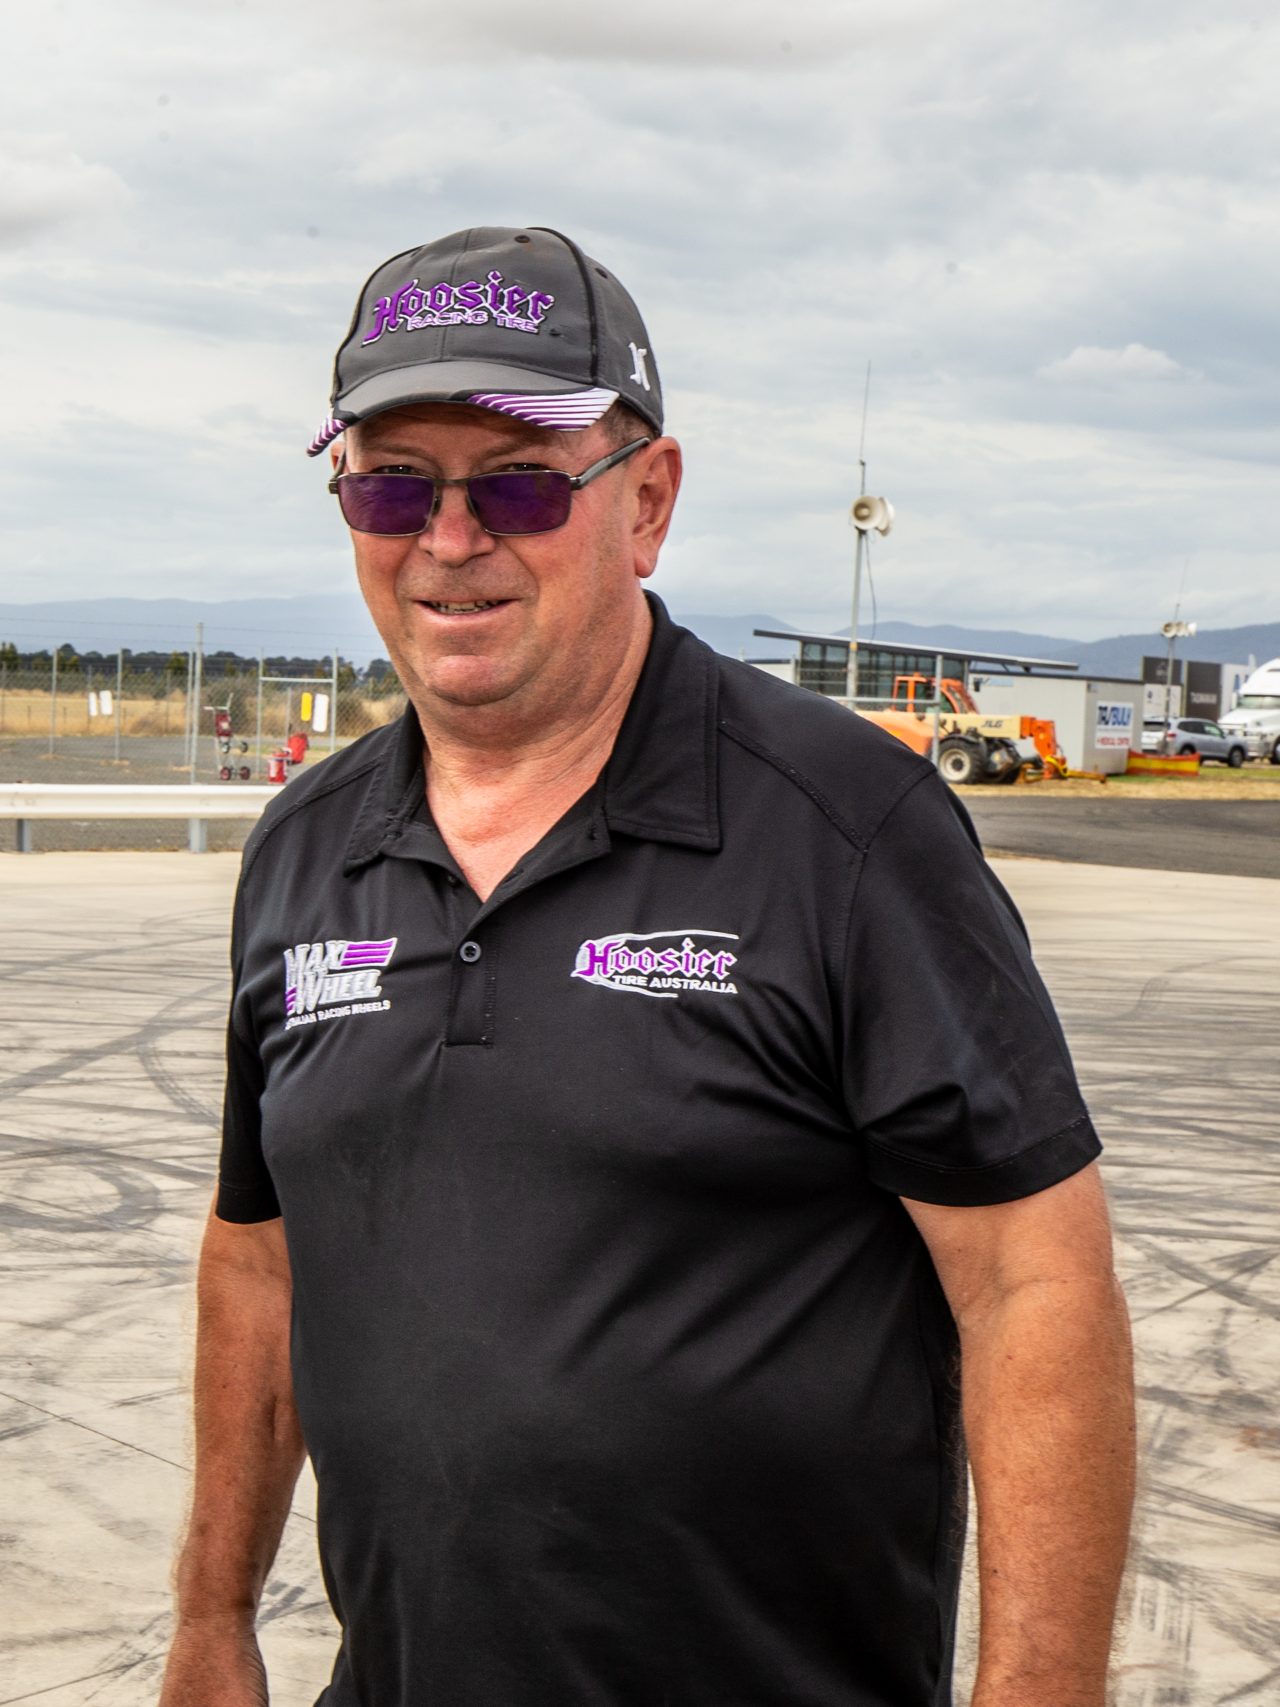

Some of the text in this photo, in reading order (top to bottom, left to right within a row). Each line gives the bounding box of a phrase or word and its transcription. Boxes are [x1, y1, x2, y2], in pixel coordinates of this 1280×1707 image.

[361, 270, 554, 346] Hoosier
[407, 311, 539, 334] RACING TIRE
[570, 937, 738, 980] Hoosier
[612, 975, 738, 994] TIRE AUSTRALIA
[317, 1006, 351, 1021] RACING
[351, 1000, 391, 1015] WHEELS
